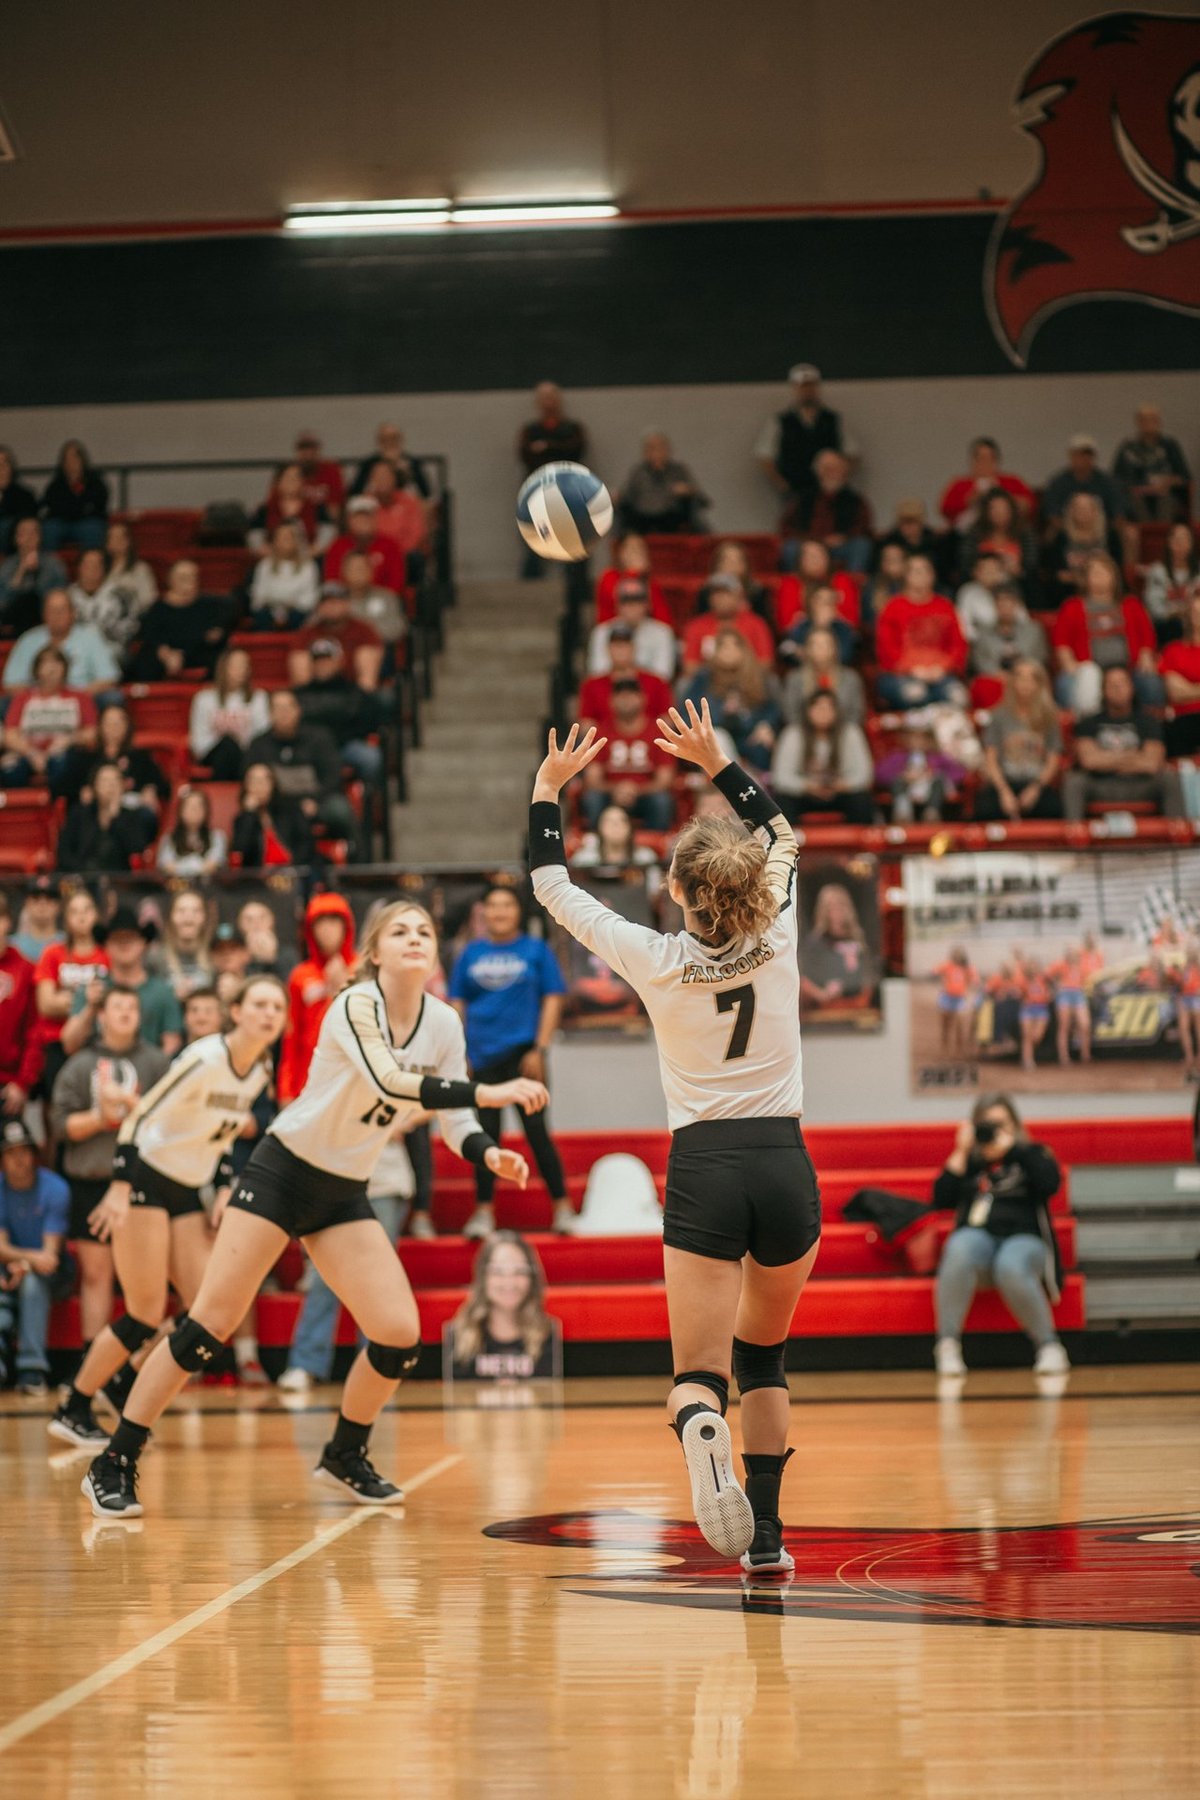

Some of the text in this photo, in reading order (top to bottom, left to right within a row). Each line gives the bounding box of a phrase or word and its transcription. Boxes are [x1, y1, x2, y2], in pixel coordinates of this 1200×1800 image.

[985, 902, 1082, 921] EAGLES
[681, 937, 775, 984] FALCONS
[714, 981, 757, 1062] 7
